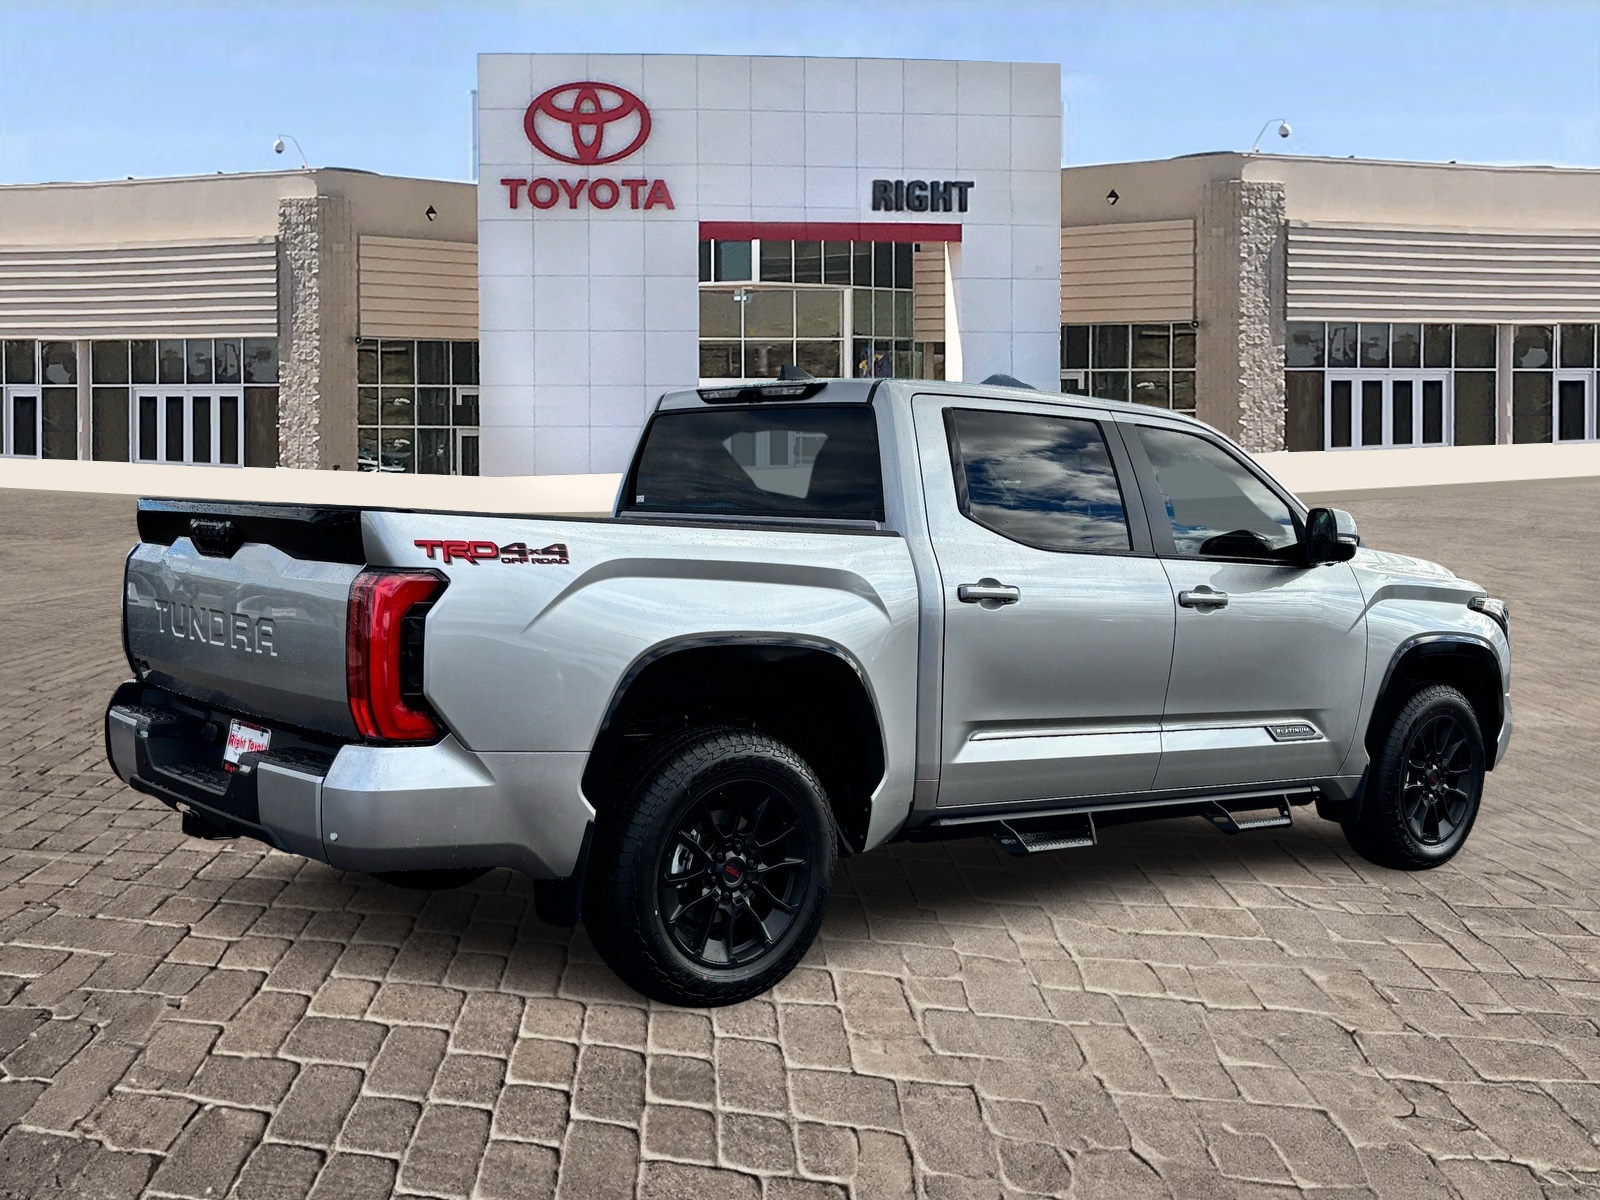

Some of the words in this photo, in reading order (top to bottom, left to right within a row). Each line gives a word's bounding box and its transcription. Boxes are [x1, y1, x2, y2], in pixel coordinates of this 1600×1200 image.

[500, 178, 675, 210] TOYOTA
[871, 179, 974, 212] RIGHT
[414, 540, 500, 565] TRD
[531, 557, 569, 565] ROAD
[154, 599, 278, 657] TUNDRA
[229, 733, 246, 750] Right
